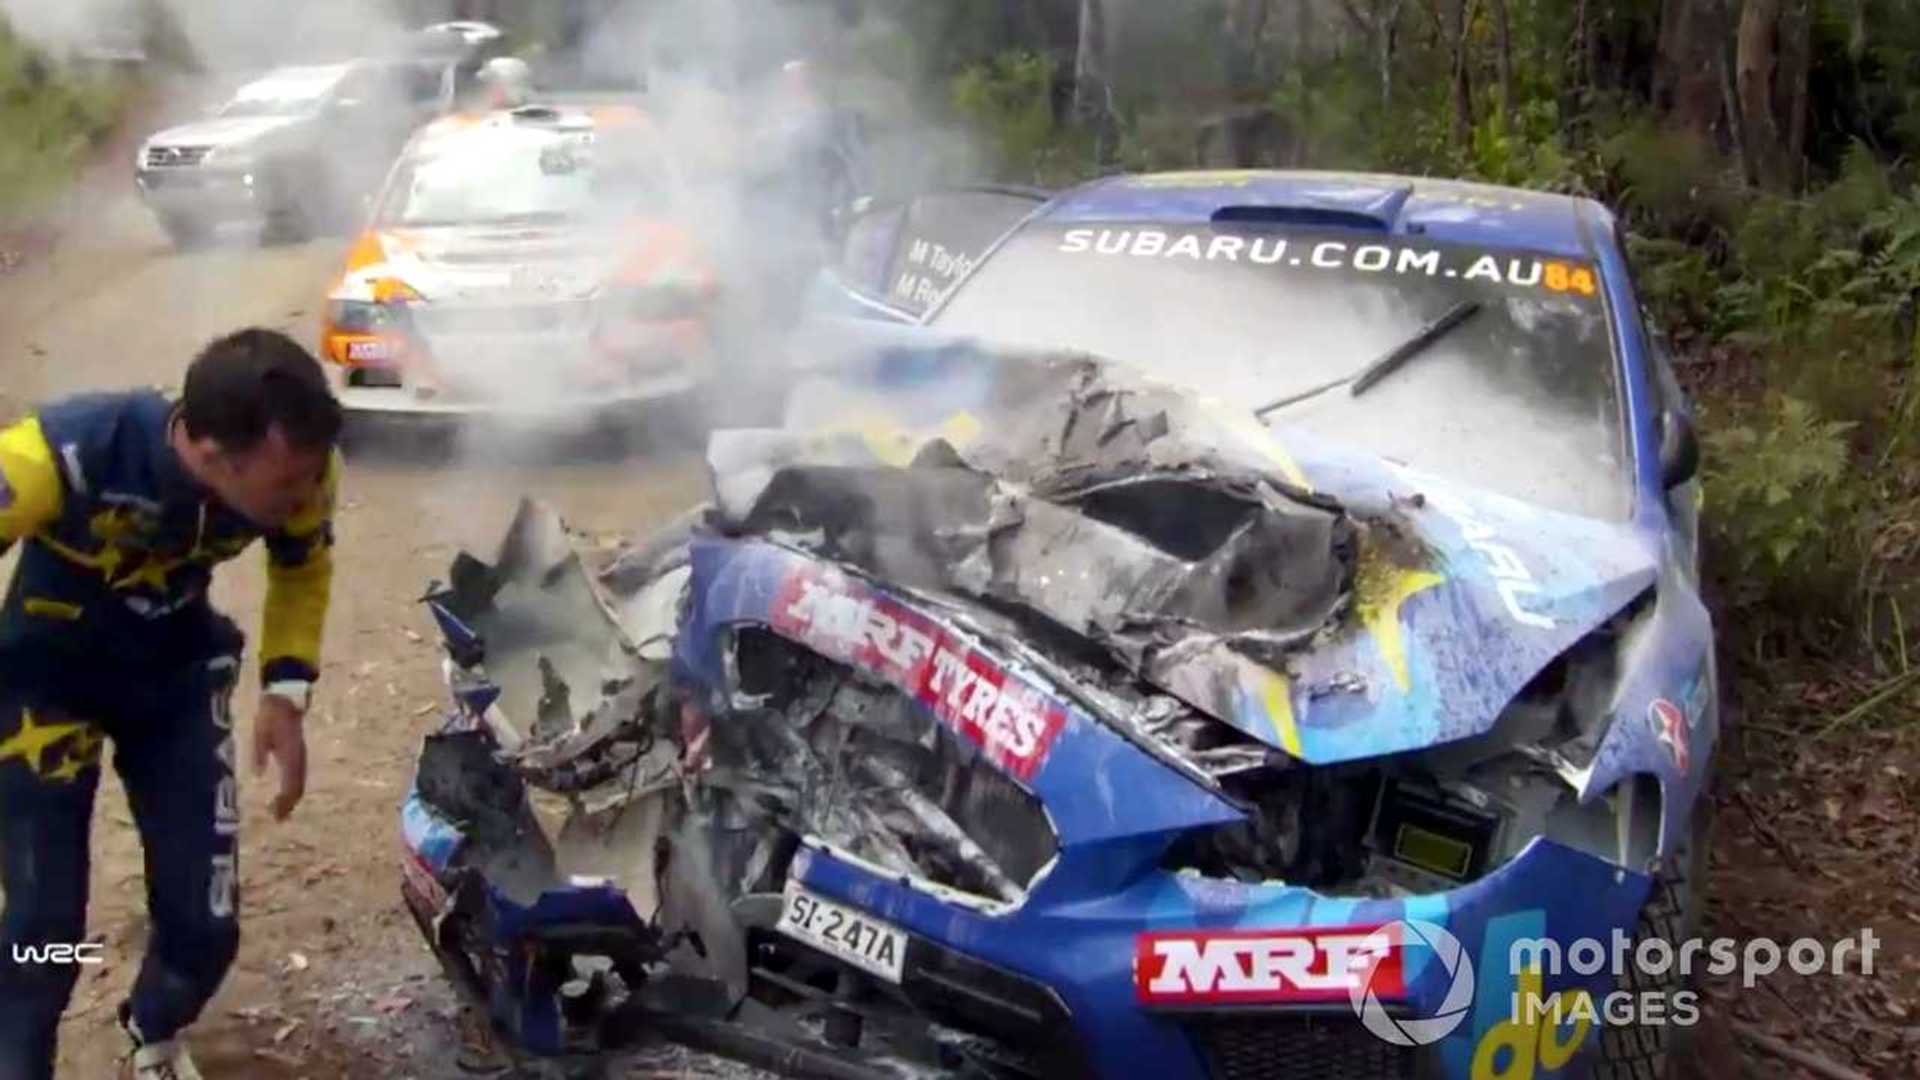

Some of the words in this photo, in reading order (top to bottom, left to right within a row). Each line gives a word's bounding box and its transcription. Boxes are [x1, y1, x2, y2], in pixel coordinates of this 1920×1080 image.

[896, 273, 917, 298] M
[909, 238, 929, 265] M
[930, 244, 977, 281] Taylo
[1059, 228, 1541, 287] SUBARU.COM.AU
[1545, 262, 1595, 295] 84
[928, 647, 1048, 758] TYRES
[1149, 934, 1391, 993] MRF
